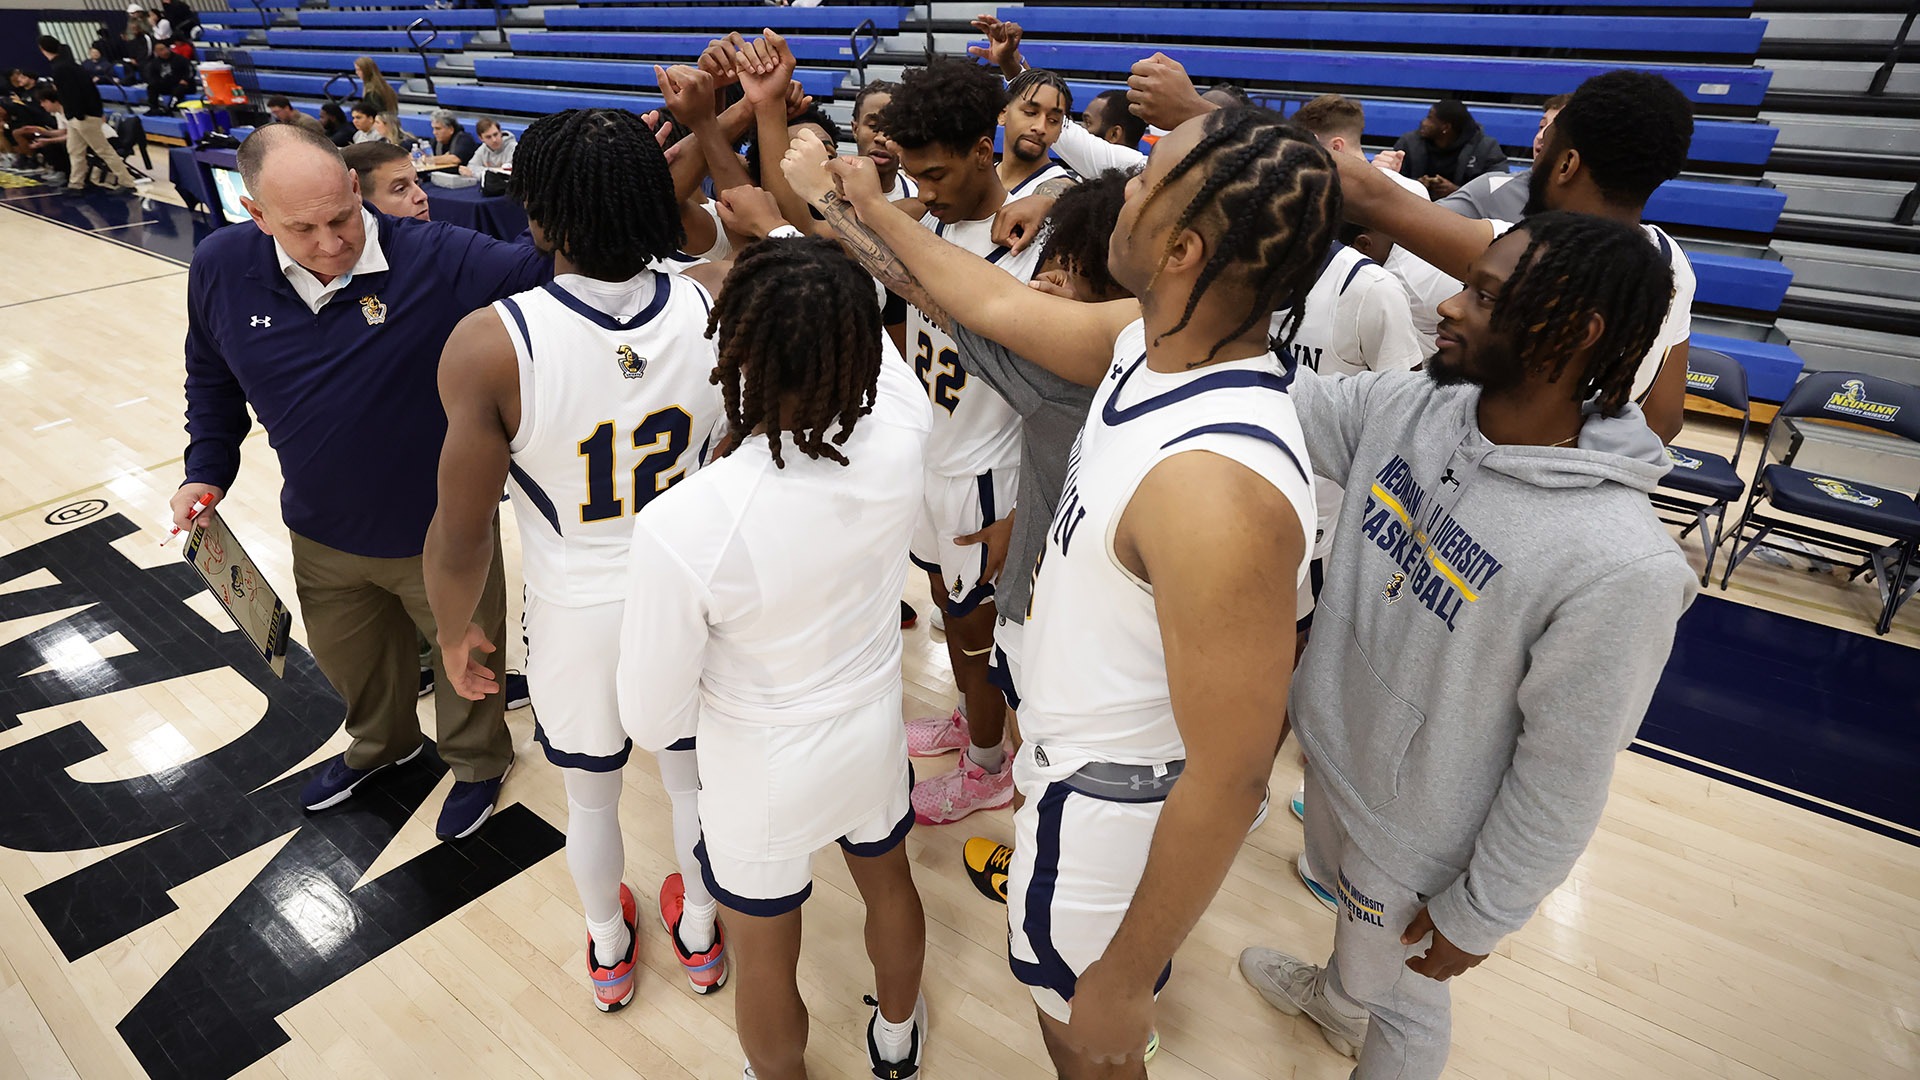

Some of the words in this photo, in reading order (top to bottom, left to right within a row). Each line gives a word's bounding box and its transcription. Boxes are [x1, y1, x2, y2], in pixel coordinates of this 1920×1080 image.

[914, 328, 969, 418] 22
[577, 404, 693, 523] 12
[1427, 503, 1503, 591] UIVERSITY
[606, 971, 615, 980] 12
[889, 1070, 898, 1079] 12
